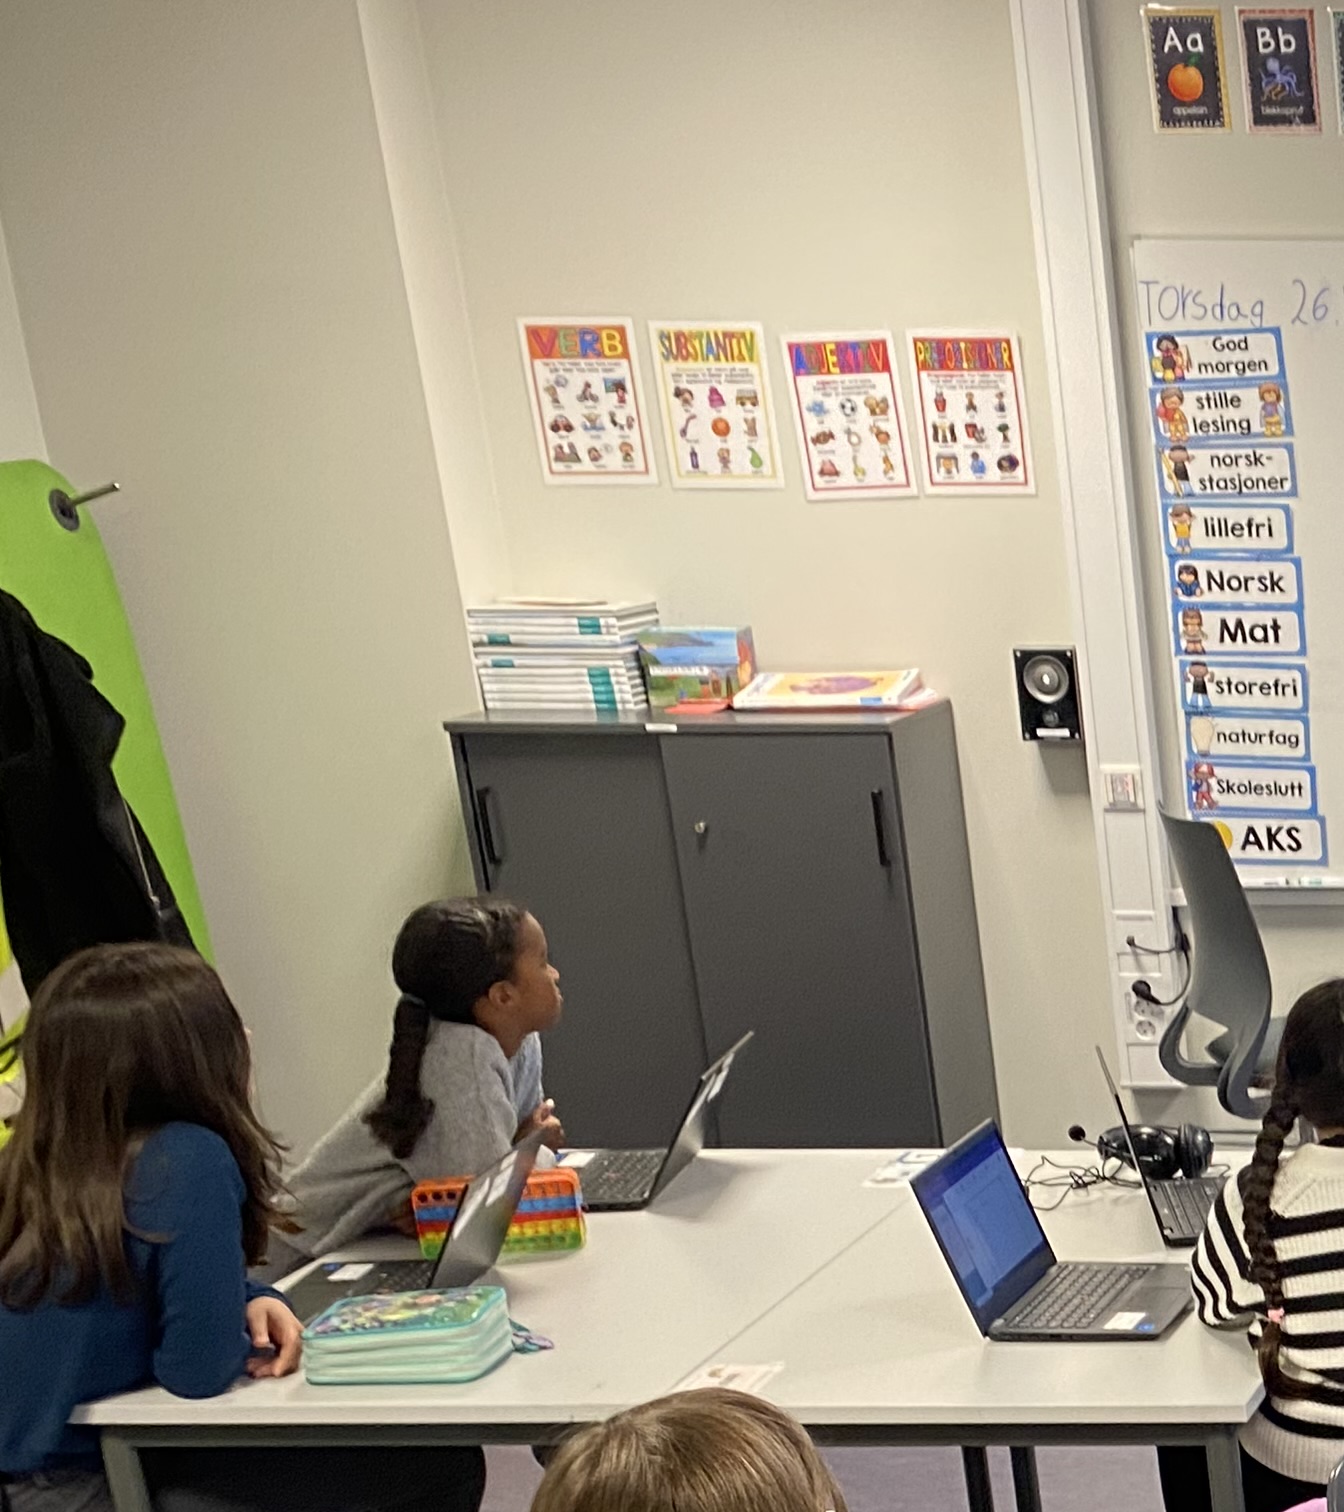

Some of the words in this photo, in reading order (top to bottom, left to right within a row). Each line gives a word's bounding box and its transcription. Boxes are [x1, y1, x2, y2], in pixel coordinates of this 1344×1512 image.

[1162, 26, 1204, 53] Aa
[1257, 26, 1297, 53] Bb
[530, 326, 625, 358] VERB
[659, 328, 756, 362] SUBSTANTIV
[1212, 335, 1249, 353] God
[1198, 356, 1269, 376] morgen
[1196, 391, 1242, 410] stille
[1193, 416, 1252, 437] lesing
[1209, 449, 1274, 468] norsk-
[1198, 472, 1289, 495] stasjoner
[1203, 517, 1274, 540] lillefri
[1205, 569, 1286, 593] Norsk
[1218, 617, 1282, 645] Mat
[1214, 676, 1299, 698] storefri
[1216, 727, 1300, 750] naturfag
[1216, 778, 1304, 799] Skoleslutt
[1240, 825, 1303, 853] AKS
